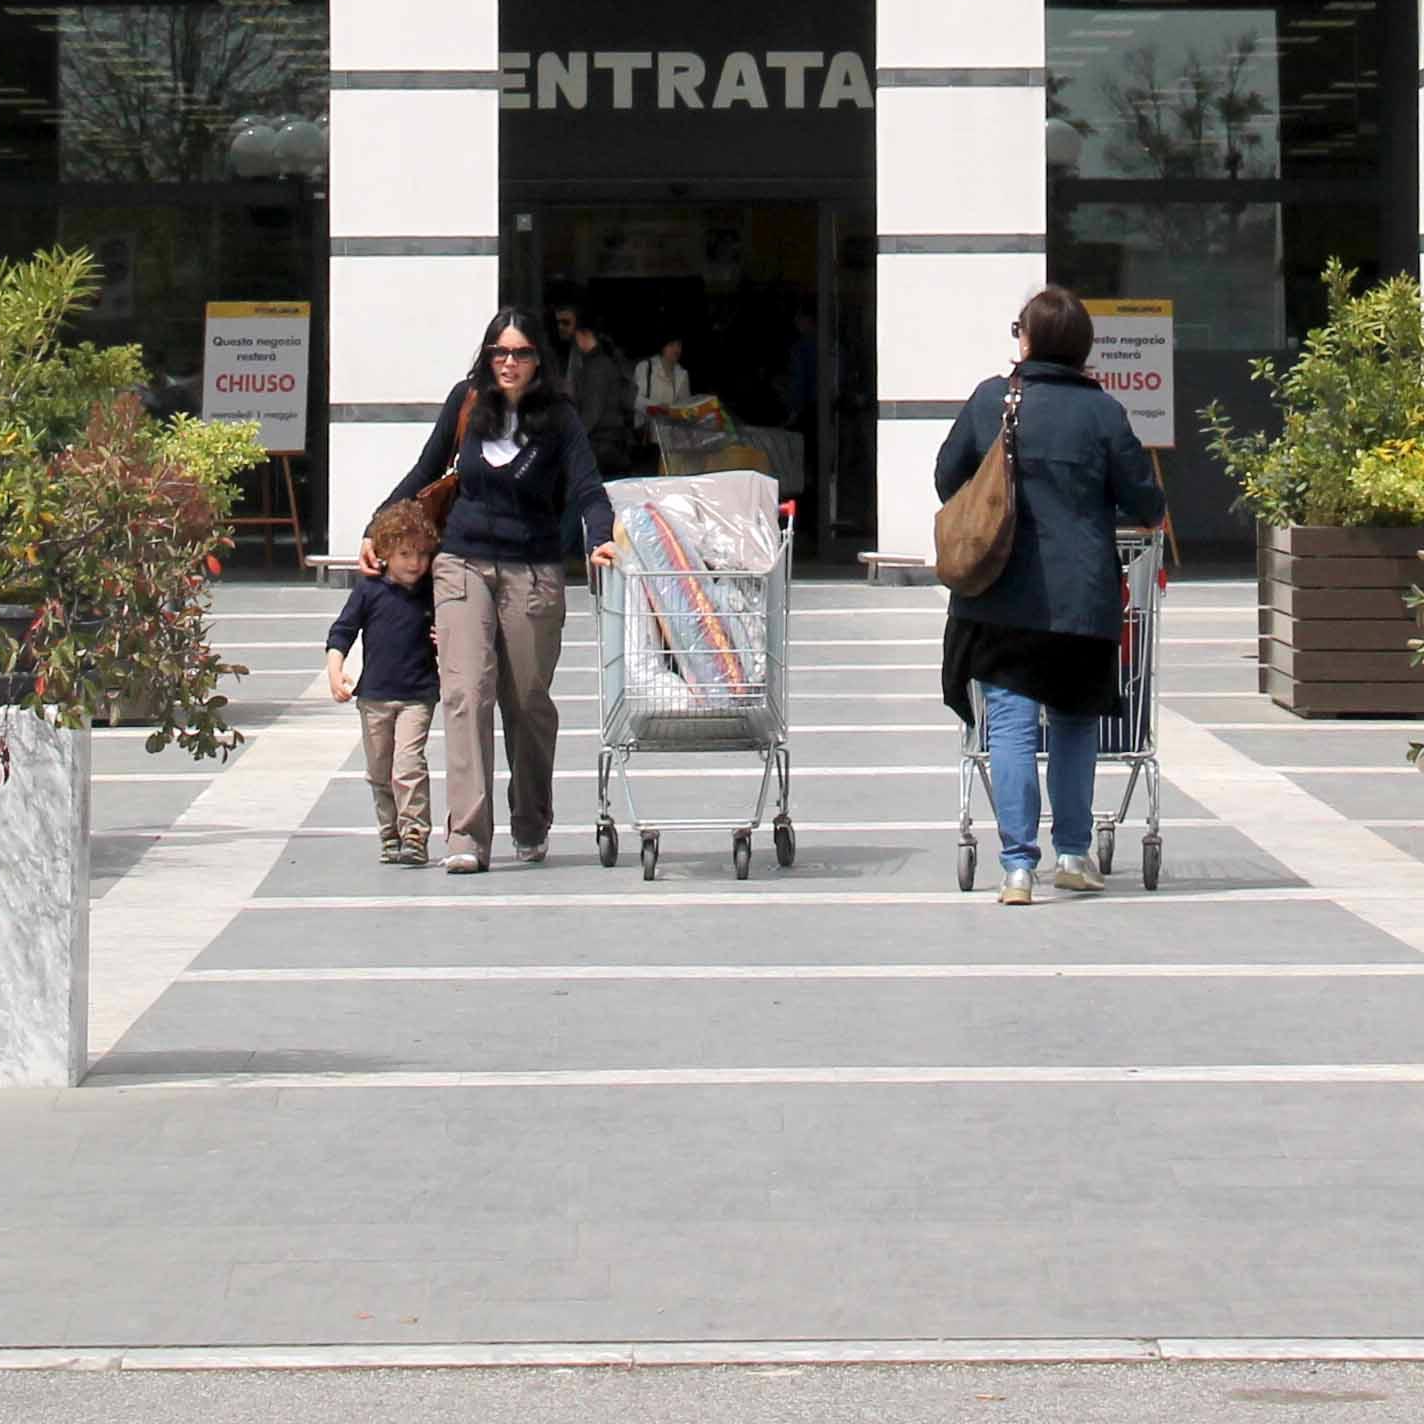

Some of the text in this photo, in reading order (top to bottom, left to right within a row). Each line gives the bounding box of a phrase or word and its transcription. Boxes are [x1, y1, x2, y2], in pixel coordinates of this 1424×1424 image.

[498, 51, 875, 110] ENTRATA
[212, 336, 302, 349] Questo negozio
[1119, 333, 1166, 348] negozio
[215, 373, 296, 393] CHIUSO
[1088, 371, 1162, 392] HIUSO
